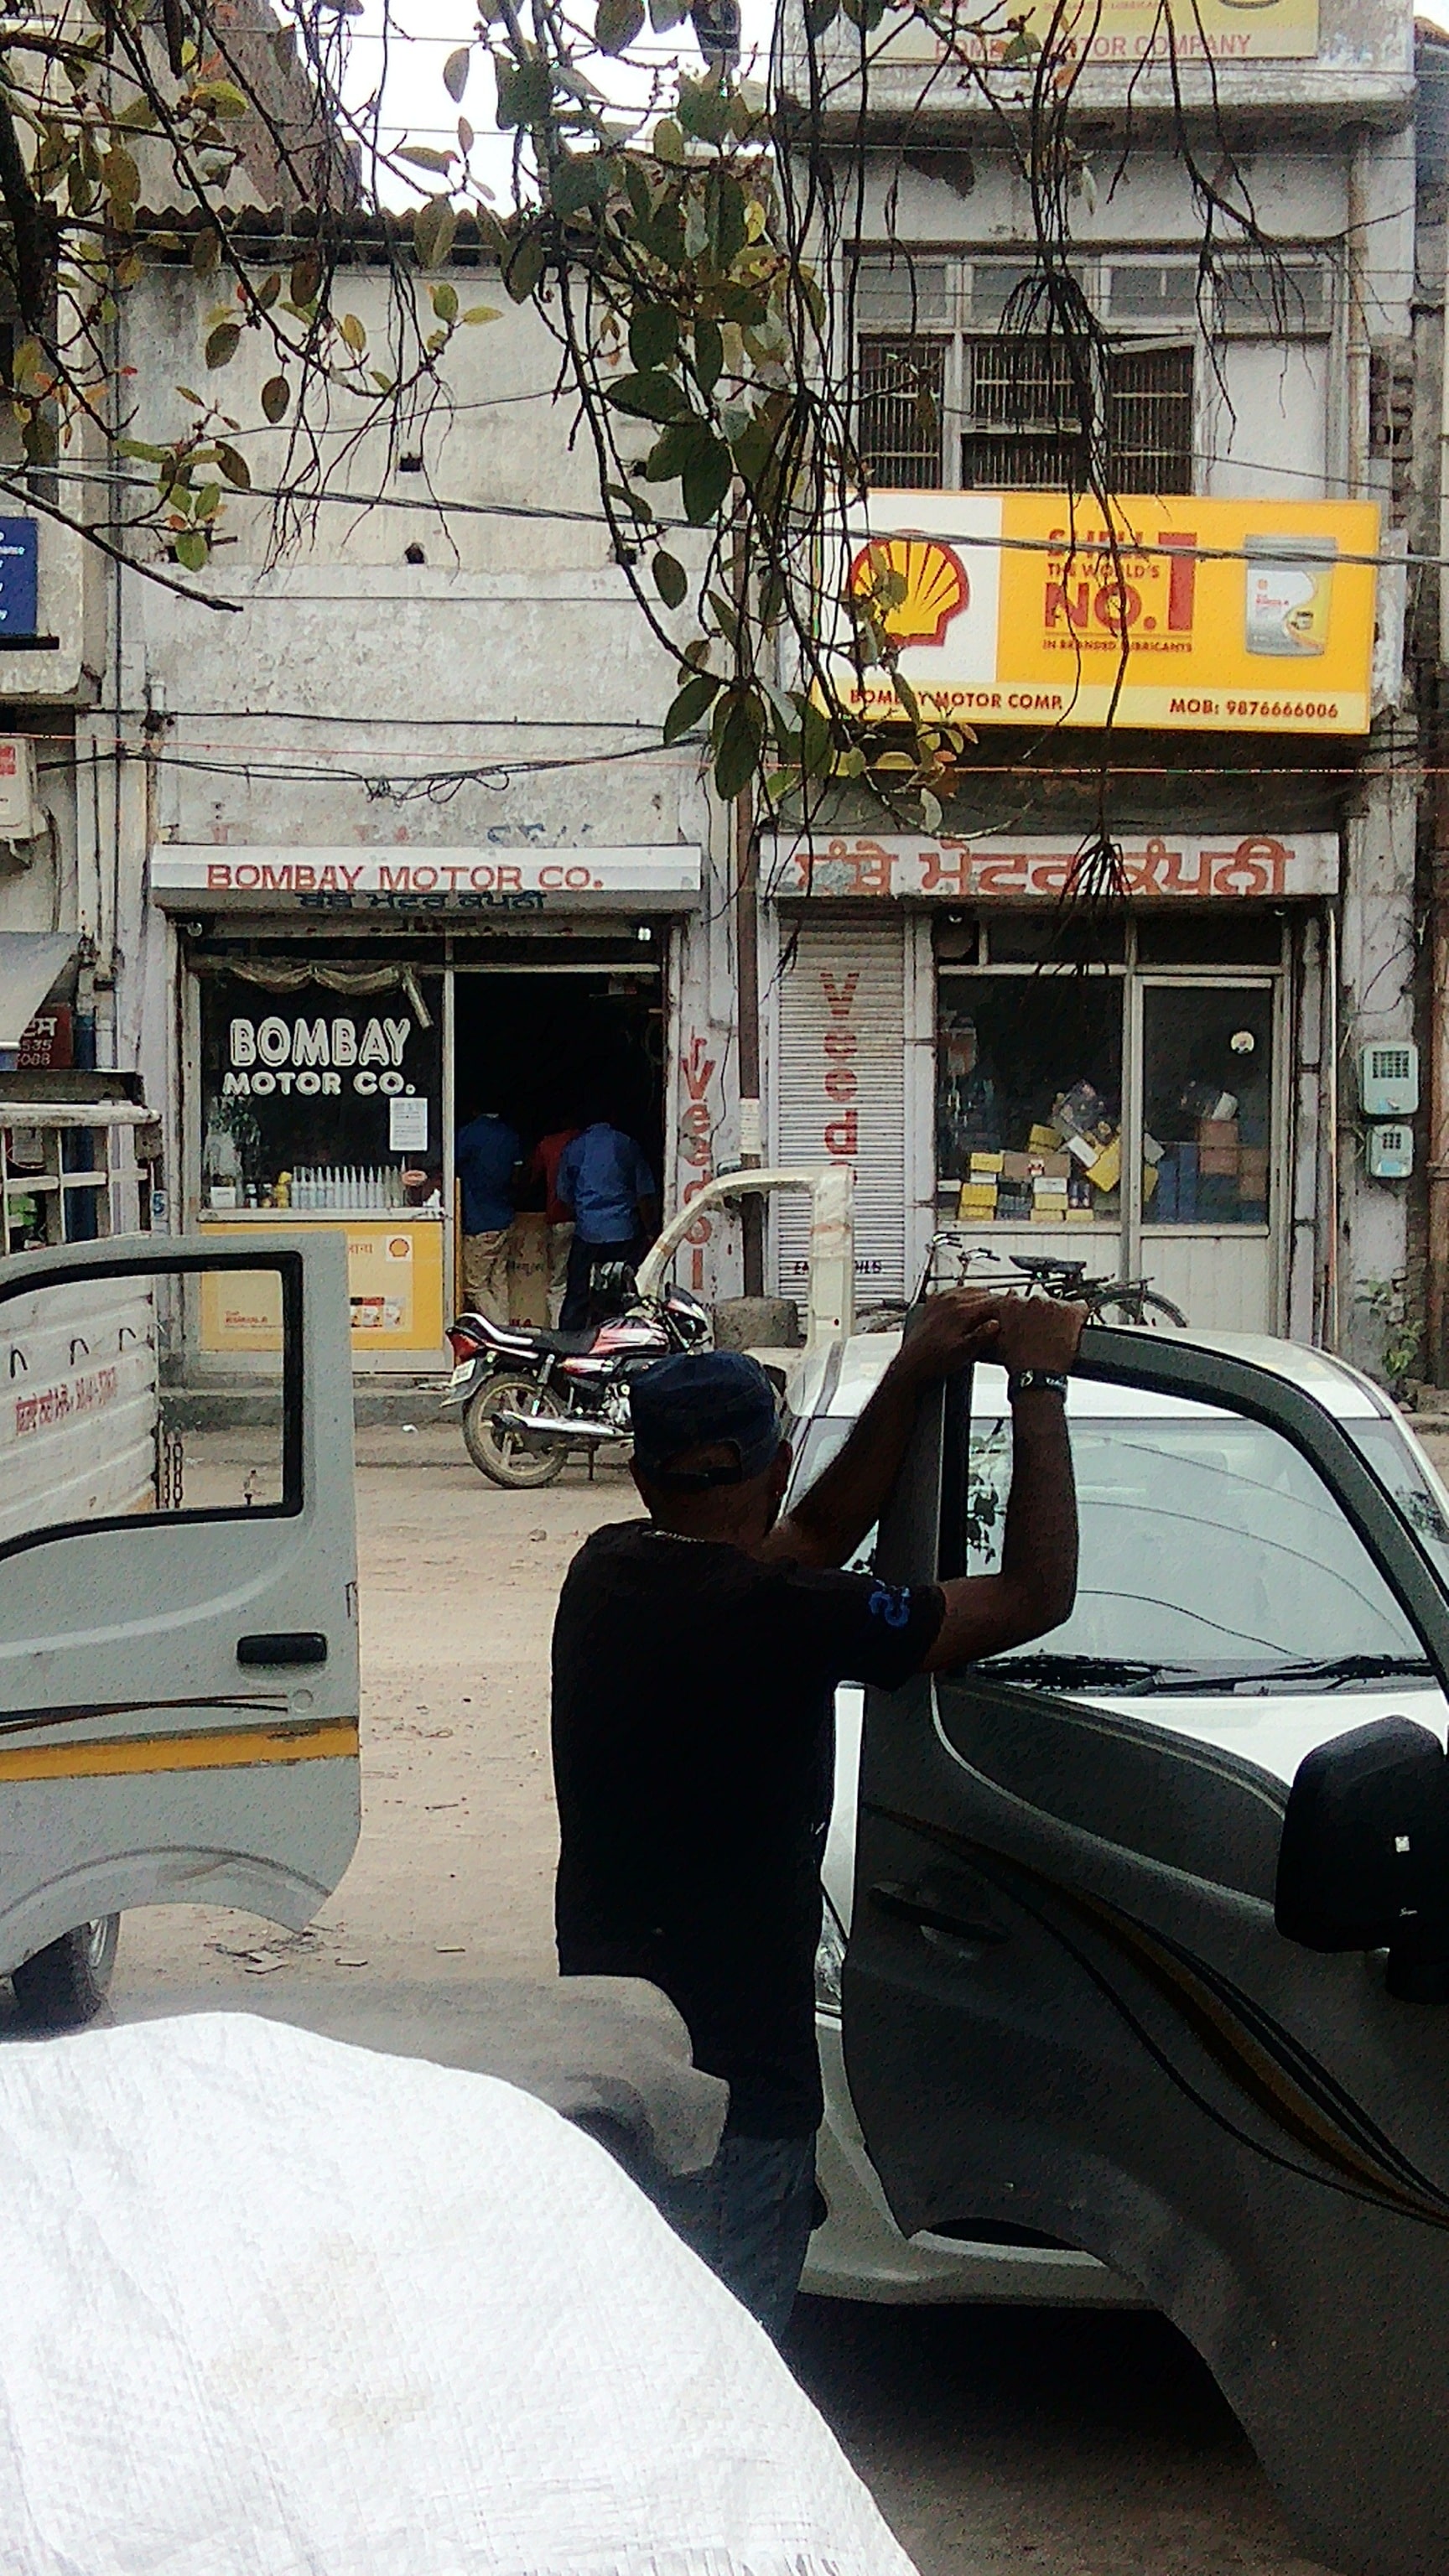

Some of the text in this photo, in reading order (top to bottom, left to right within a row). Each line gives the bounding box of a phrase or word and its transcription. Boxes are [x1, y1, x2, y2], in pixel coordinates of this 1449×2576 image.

[1081, 564, 1160, 579] WOLD'S
[1124, 641, 1192, 653] UBRICANTS
[850, 689, 930, 707] BOMY
[935, 691, 1002, 709] MOTOR
[1226, 699, 1338, 719] 9876666006
[206, 863, 605, 892] BOMBAY MOTOR CO.
[230, 1016, 411, 1067] BOMBAY
[222, 1071, 417, 1095] MOTOR CO.
